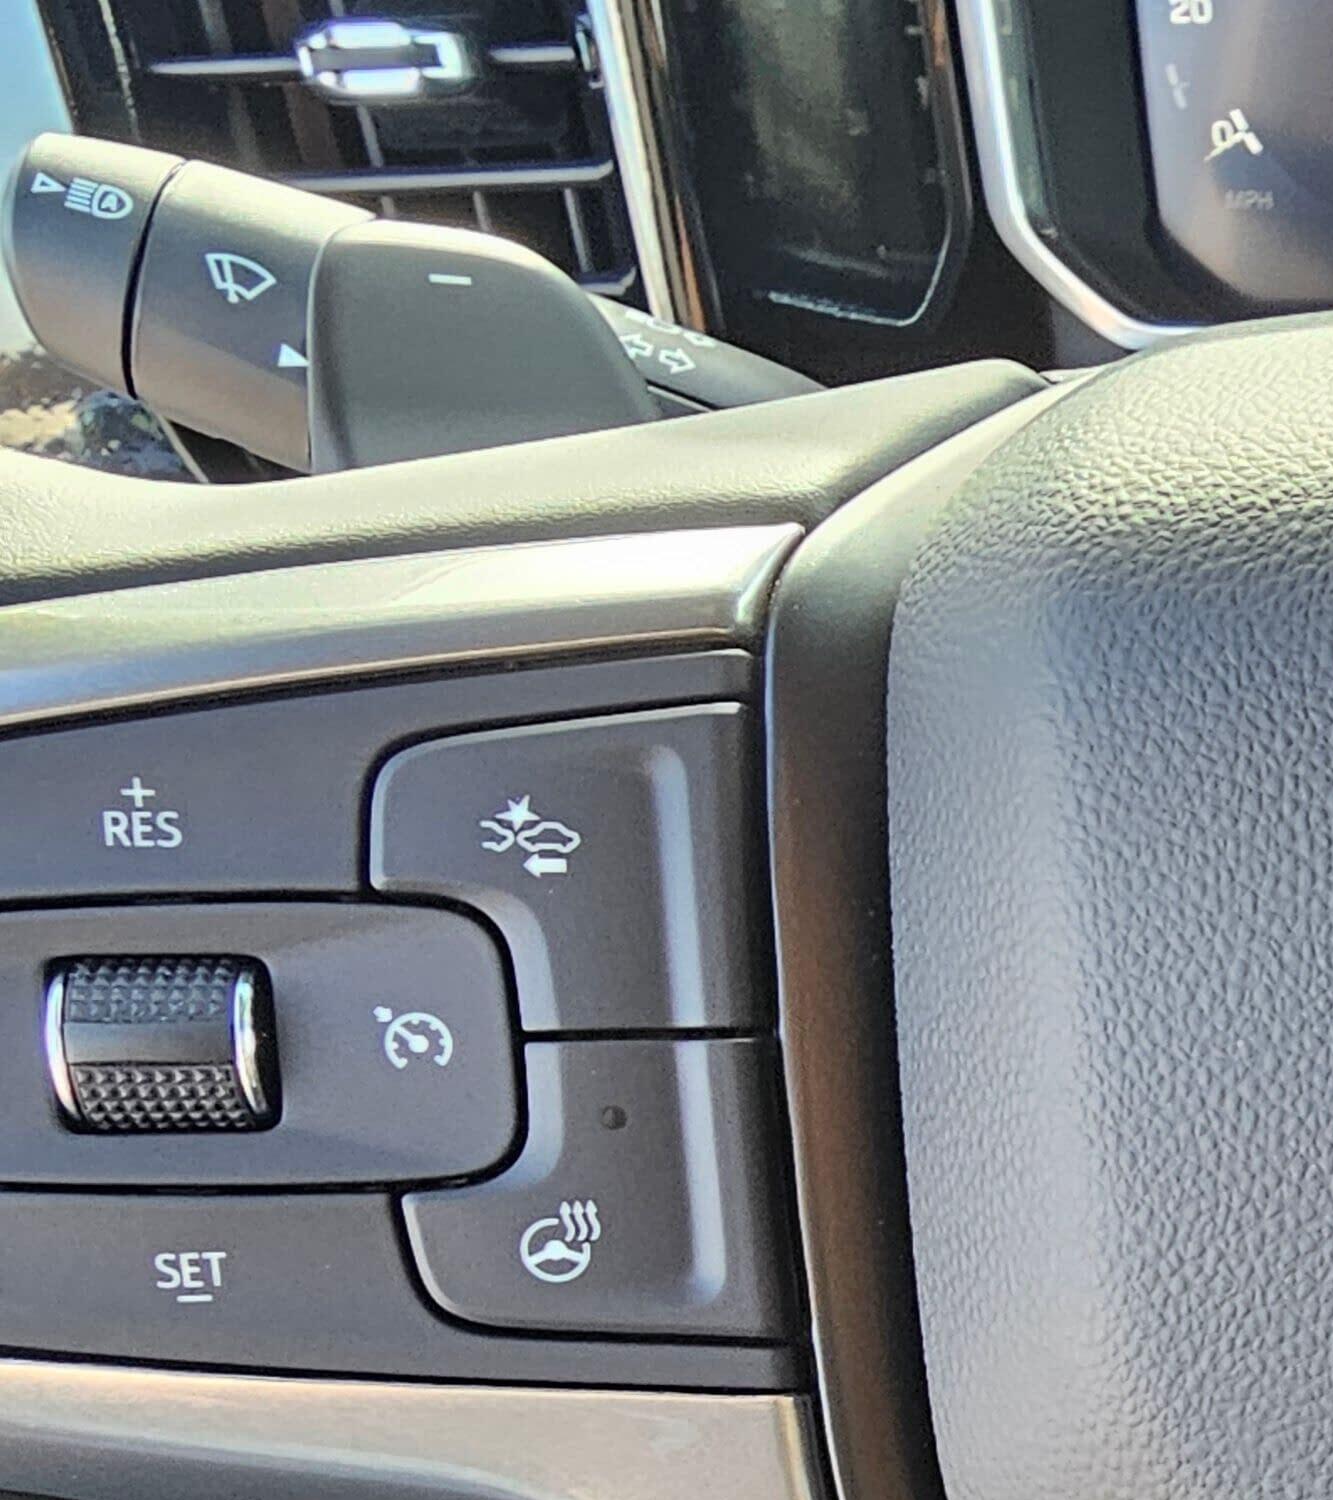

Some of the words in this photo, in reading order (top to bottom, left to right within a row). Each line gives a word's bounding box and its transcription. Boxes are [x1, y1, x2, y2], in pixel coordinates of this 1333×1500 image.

[1168, 0, 1214, 25] 20
[102, 810, 183, 848] RES
[154, 1251, 227, 1289] SET
